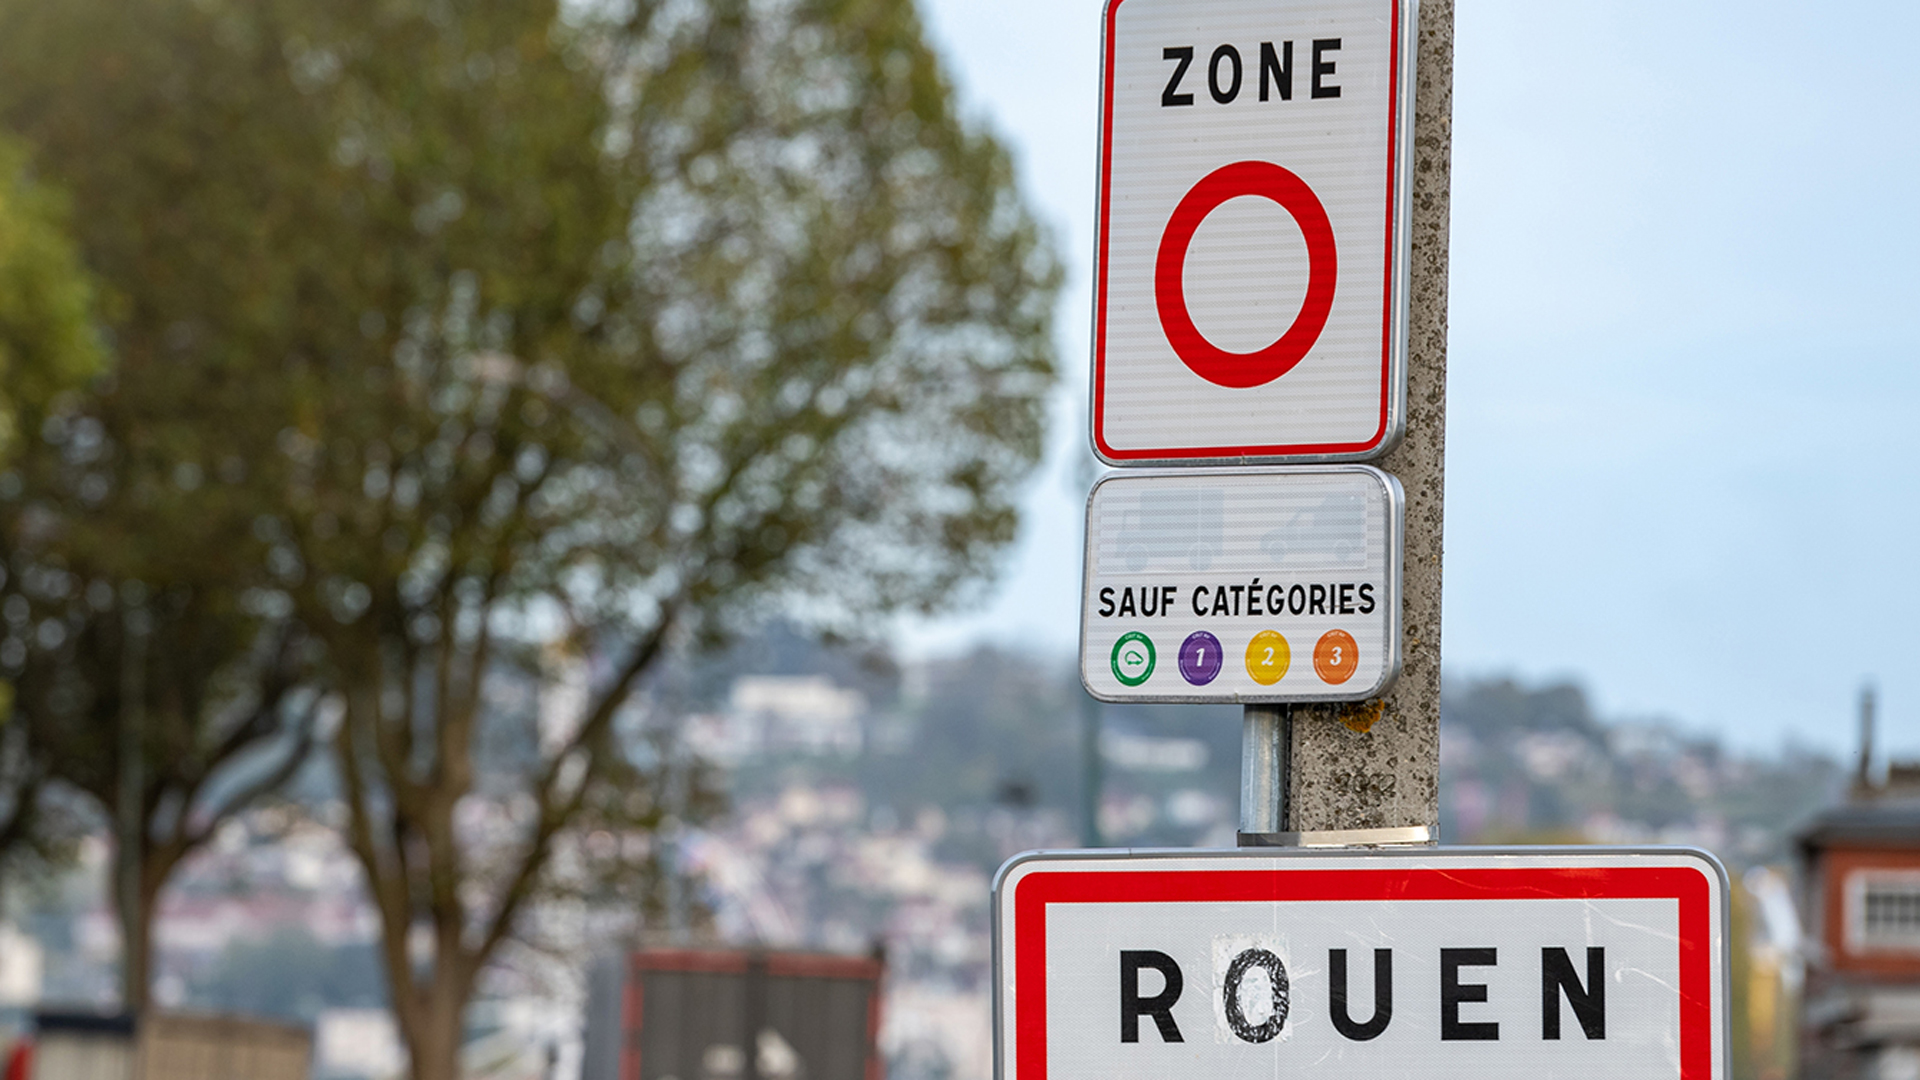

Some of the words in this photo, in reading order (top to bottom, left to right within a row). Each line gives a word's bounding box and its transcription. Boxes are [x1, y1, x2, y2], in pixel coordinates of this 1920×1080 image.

[1161, 38, 1342, 107] ZONE
[1098, 586, 1178, 618] SAUF
[1191, 577, 1376, 617] CATÉGORIES
[1196, 648, 1205, 667] 1
[1261, 647, 1274, 666] 2
[1330, 646, 1342, 666] 3
[1119, 946, 1607, 1044] ROUEN
